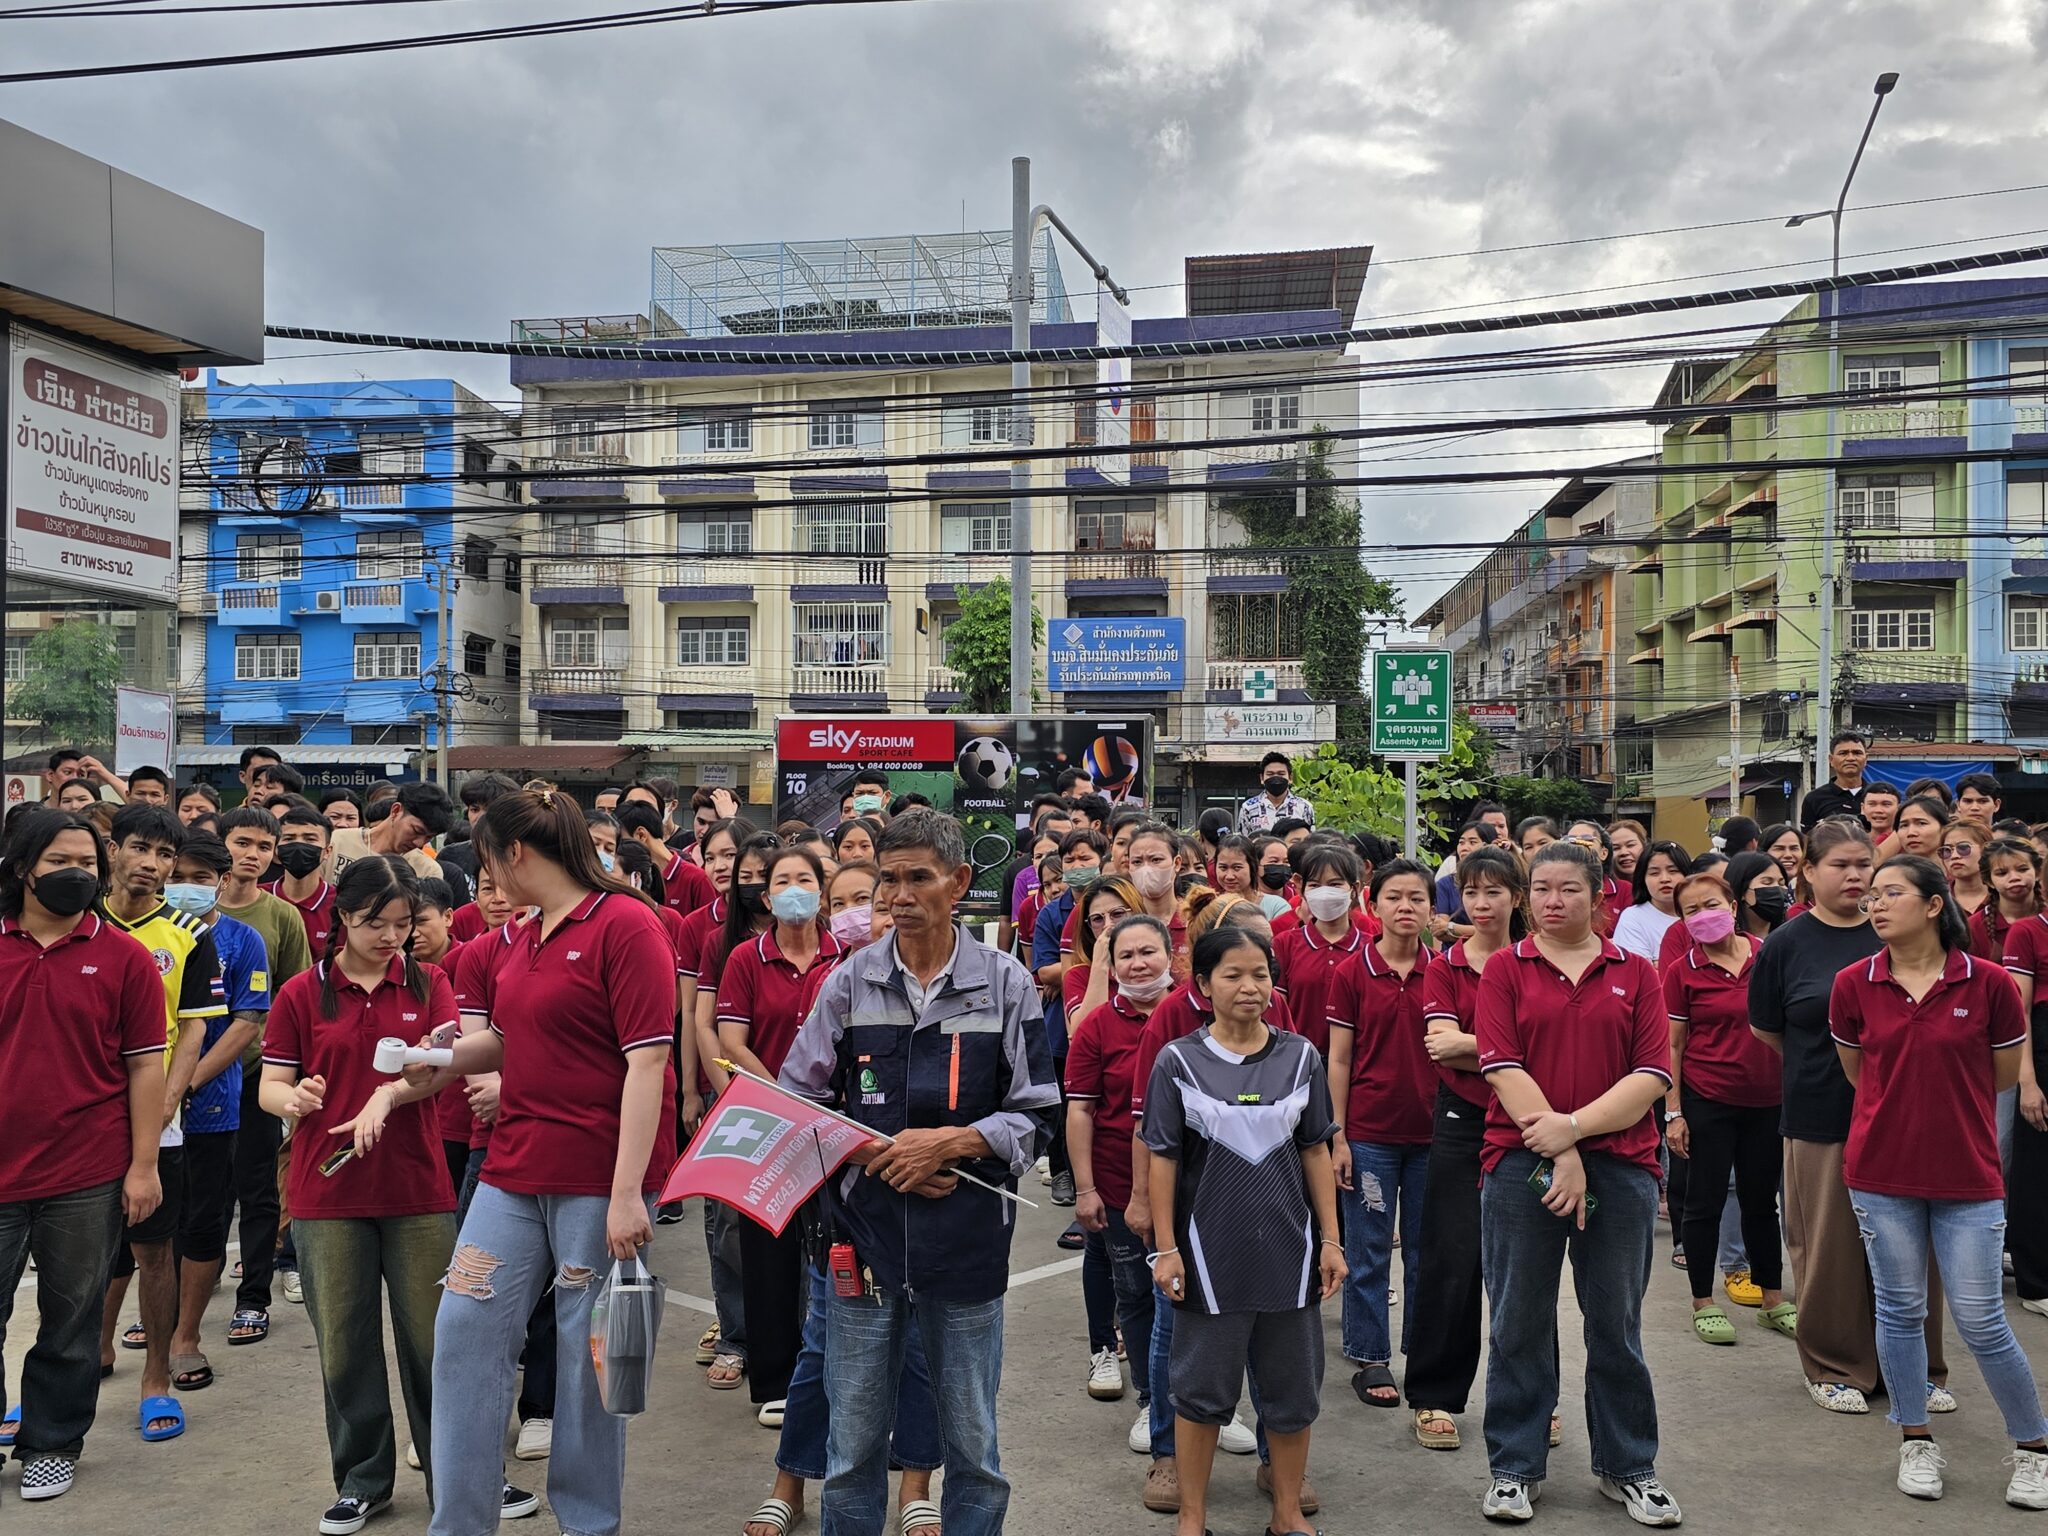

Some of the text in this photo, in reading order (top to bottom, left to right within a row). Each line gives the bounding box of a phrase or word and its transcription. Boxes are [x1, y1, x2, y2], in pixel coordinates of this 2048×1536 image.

[16, 414, 171, 486] ข้าวมันไก่สิงคโปร์
[59, 490, 136, 524] ข้าวมันหมูกรอบ
[61, 550, 134, 577] สาขาพระราม2
[1092, 624, 1166, 639] สำนักงานตัวแทน
[1052, 640, 1178, 663] บมจ.สินมั่นคงประกันภัย
[1059, 666, 1171, 688] รับประกันภัยรถทุกชนิด
[1242, 711, 1288, 723] พระราม
[1245, 723, 1299, 737] การแพทย์
[1385, 725, 1438, 738] จุดรวมพล
[808, 724, 915, 754] sky STADIUM
[1380, 737, 1443, 747] Assembly Point
[859, 749, 914, 757] SPORT CAFE
[826, 762, 855, 771] Booking
[867, 762, 883, 770] 084
[884, 762, 901, 770] 000
[303, 769, 376, 786] เครื่องเย็น
[786, 780, 807, 795] 10
[964, 799, 1007, 808] FOOTBALL
[969, 890, 998, 898] TENNIS
[1237, 1094, 1261, 1102] SPORT
